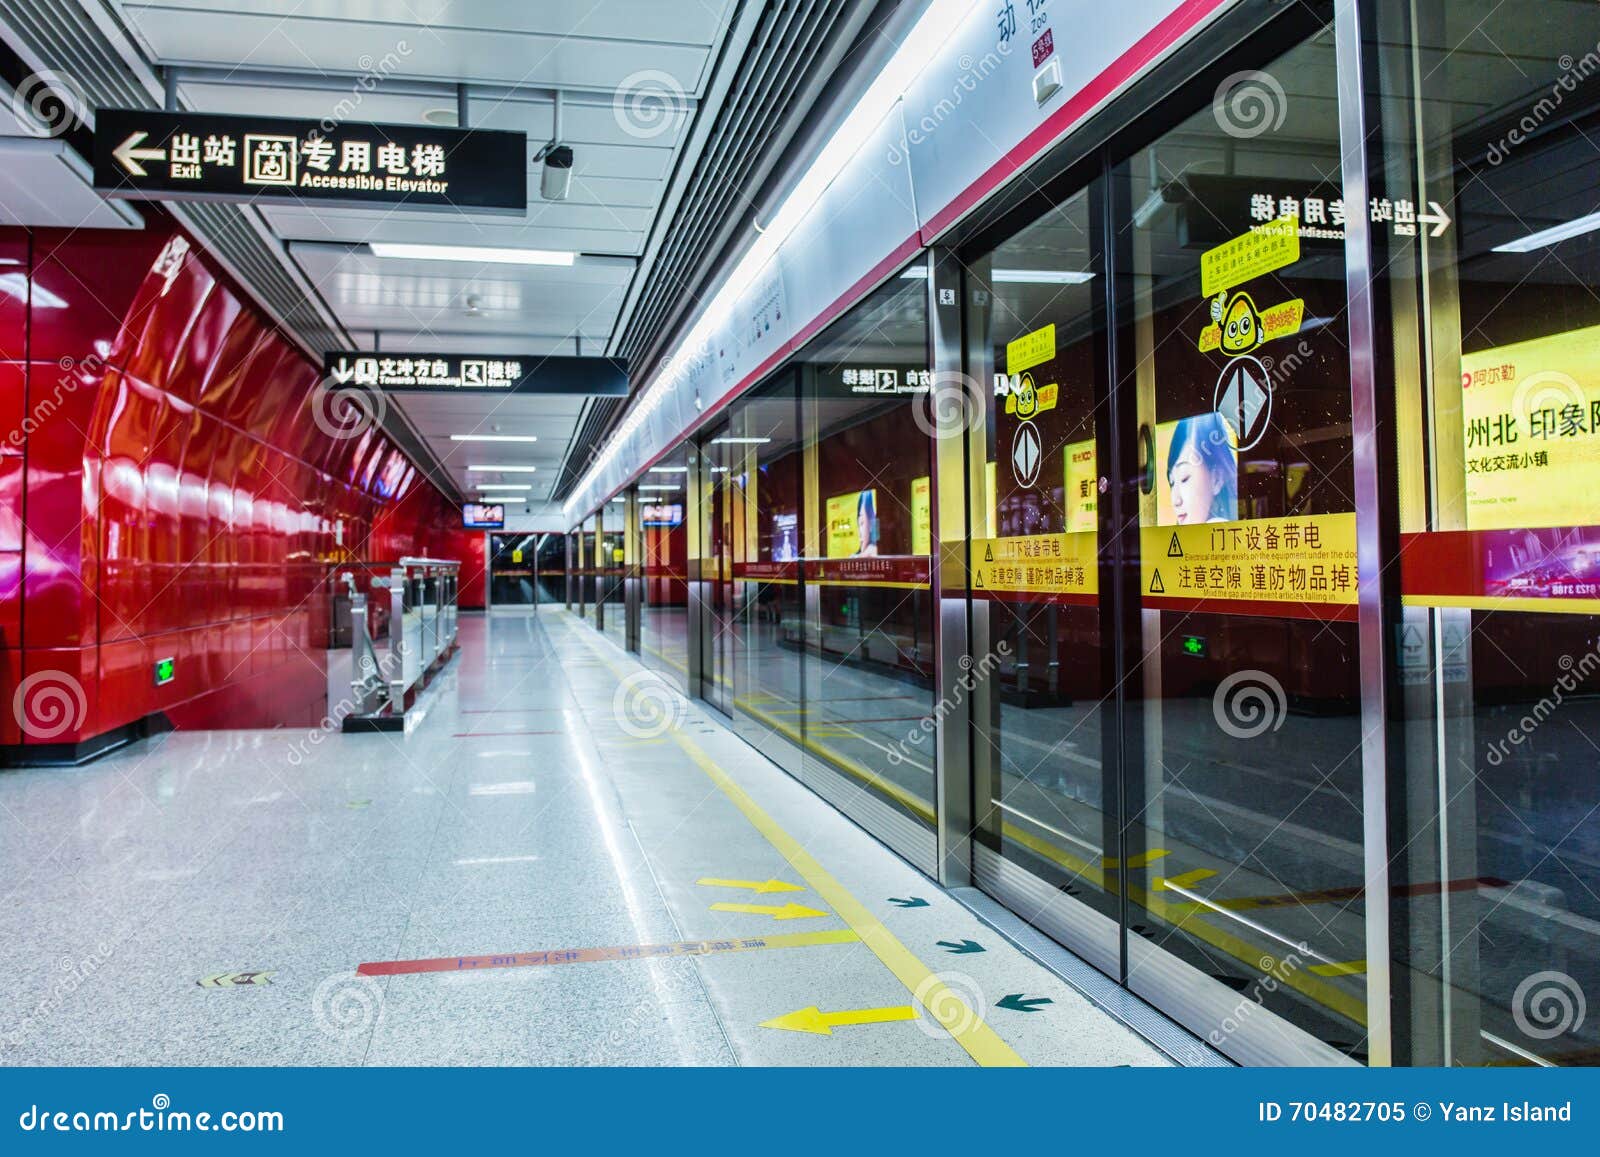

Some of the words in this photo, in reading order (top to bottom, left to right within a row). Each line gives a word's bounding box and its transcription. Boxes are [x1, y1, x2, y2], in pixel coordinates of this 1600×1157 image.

[1031, 12, 1047, 34] Zoo
[170, 133, 236, 166] 出站
[301, 138, 447, 176] 专用电梯
[170, 163, 202, 180] Exit
[300, 172, 384, 191] Accessible
[385, 176, 449, 194] Elevator
[1473, 365, 1515, 386] 阿尔勒
[1467, 413, 1518, 448] 州北
[1530, 400, 1600, 440] 印象
[1467, 451, 1548, 474] 文化交流小镇
[1211, 522, 1322, 551] 门下设备带电
[1006, 538, 1061, 558] 门下设备带电
[1231, 552, 1249, 560] exists
[1260, 552, 1270, 560] the
[1271, 551, 1307, 562] equipment
[1308, 551, 1329, 559] under
[1330, 550, 1342, 559] the
[990, 567, 1023, 585] 注意空隙
[1026, 567, 1085, 586] 谨防物品掉落
[1178, 565, 1242, 589] 注意空隙
[1251, 591, 1278, 600] prevent
[1279, 592, 1304, 600] articles
[1305, 592, 1328, 603] falling
